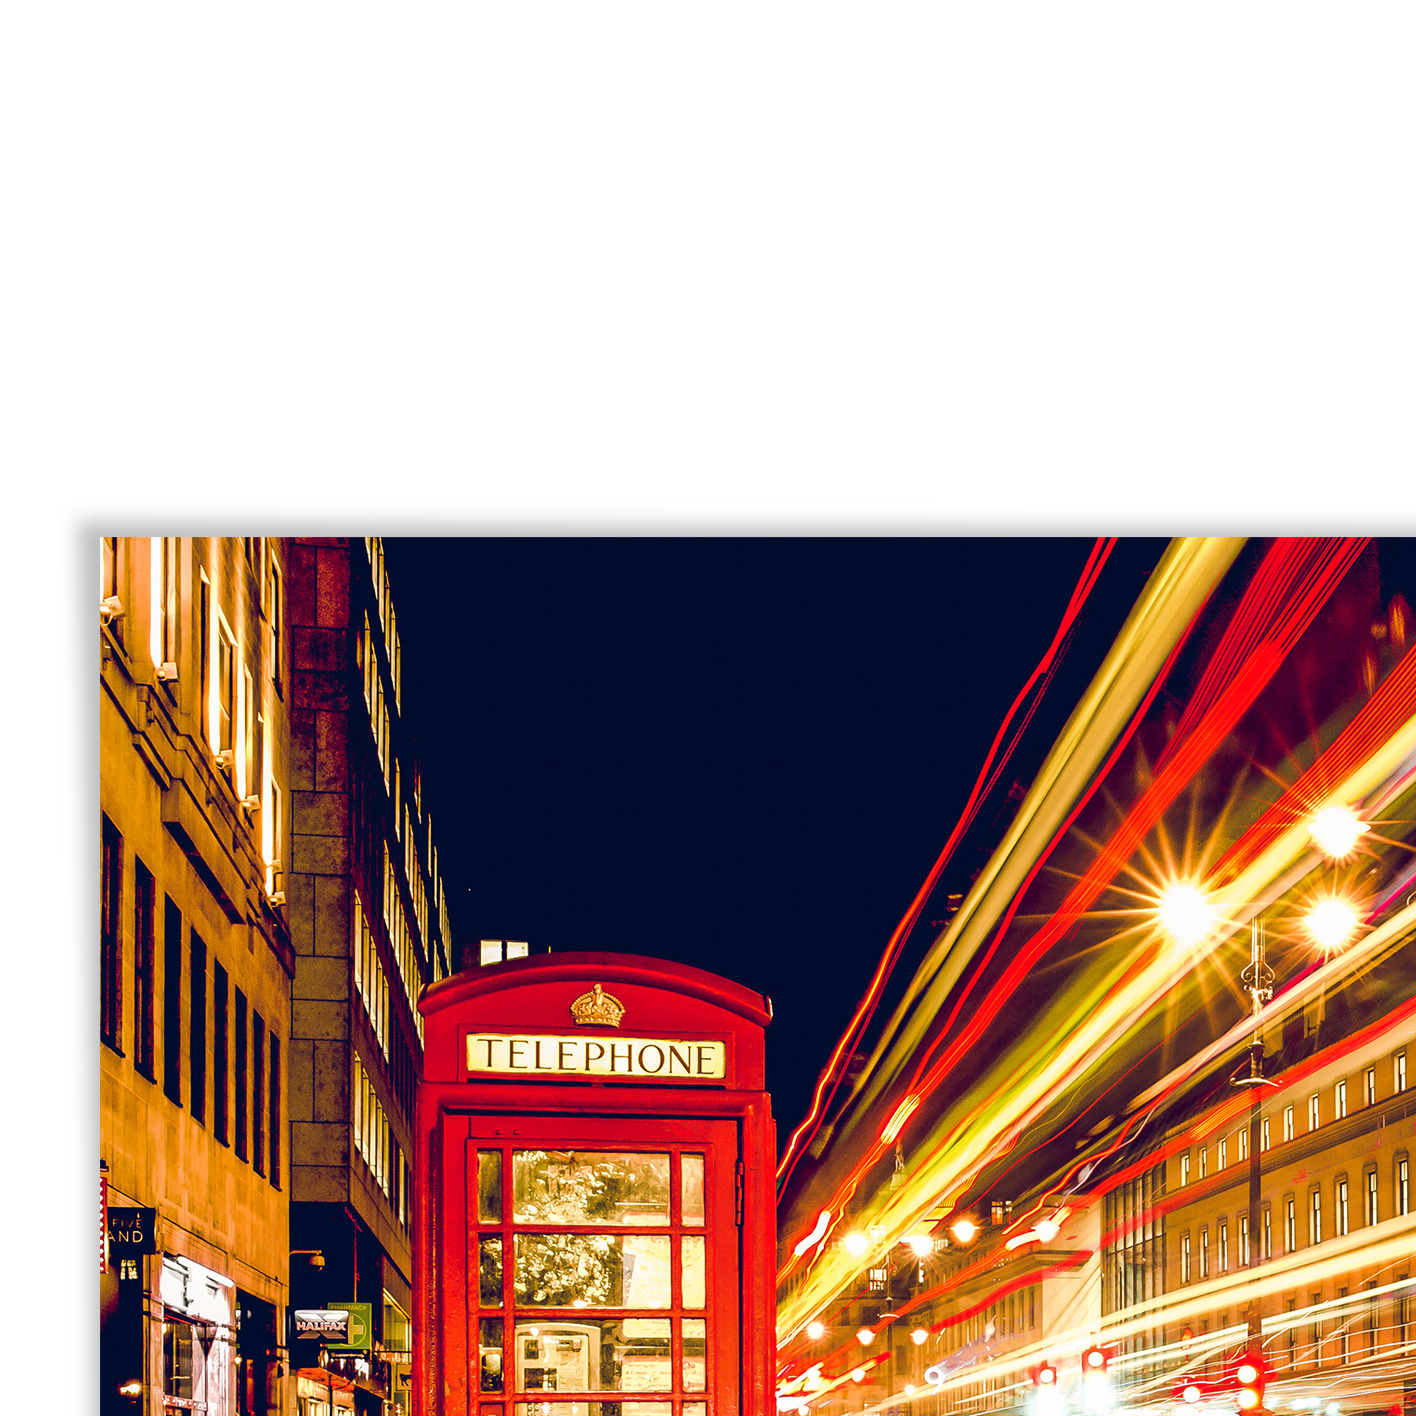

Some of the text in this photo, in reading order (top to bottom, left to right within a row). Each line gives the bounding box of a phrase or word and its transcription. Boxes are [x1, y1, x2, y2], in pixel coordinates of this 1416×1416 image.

[477, 1038, 716, 1075] TELEPHONE
[112, 1219, 142, 1229] FIVE
[297, 1321, 347, 1332] HALIFAX
